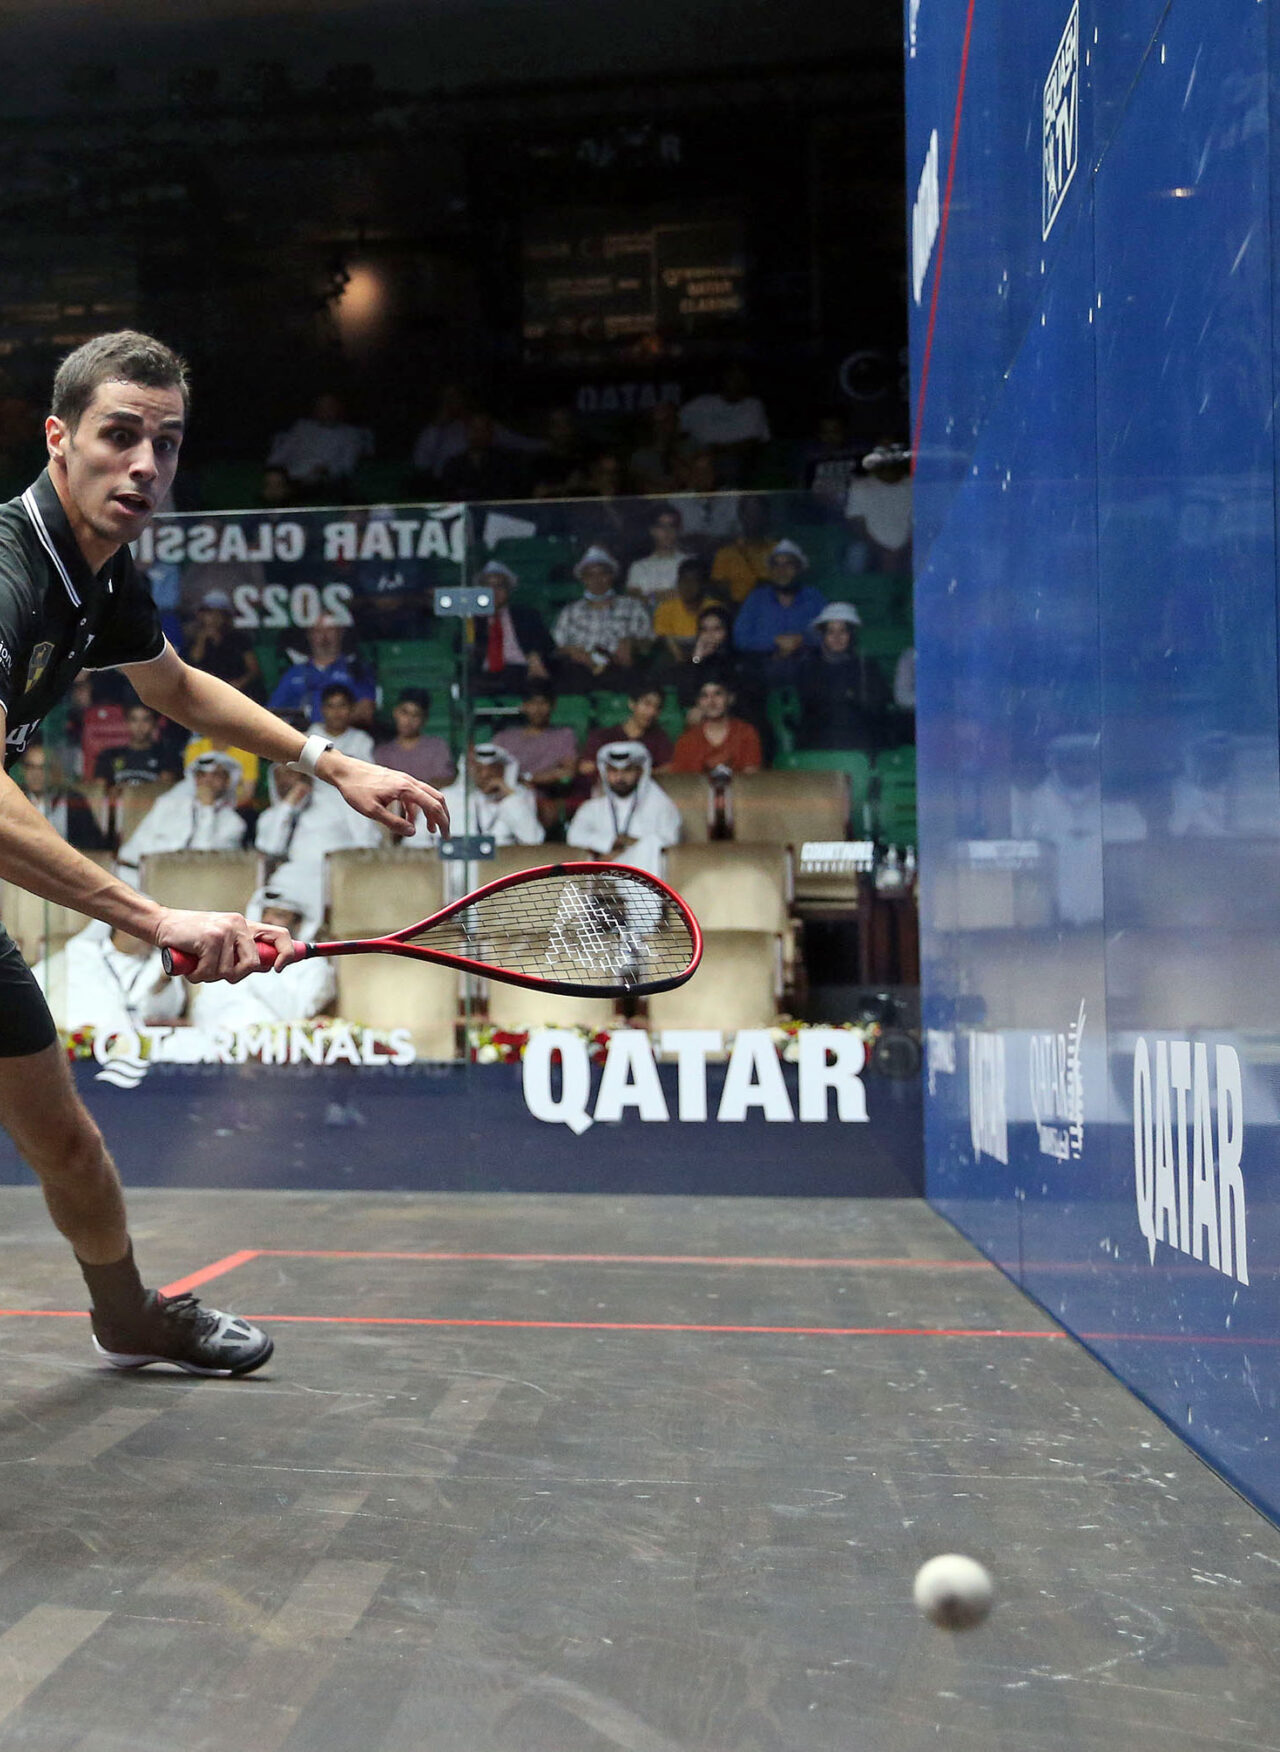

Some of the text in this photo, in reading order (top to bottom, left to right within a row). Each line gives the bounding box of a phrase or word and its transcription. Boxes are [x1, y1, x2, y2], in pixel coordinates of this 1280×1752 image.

[1045, 16, 1077, 136] SQUASH
[1055, 72, 1077, 190] TV
[522, 1029, 870, 1135] QATAR
[1133, 1036, 1249, 1286] QATAR
